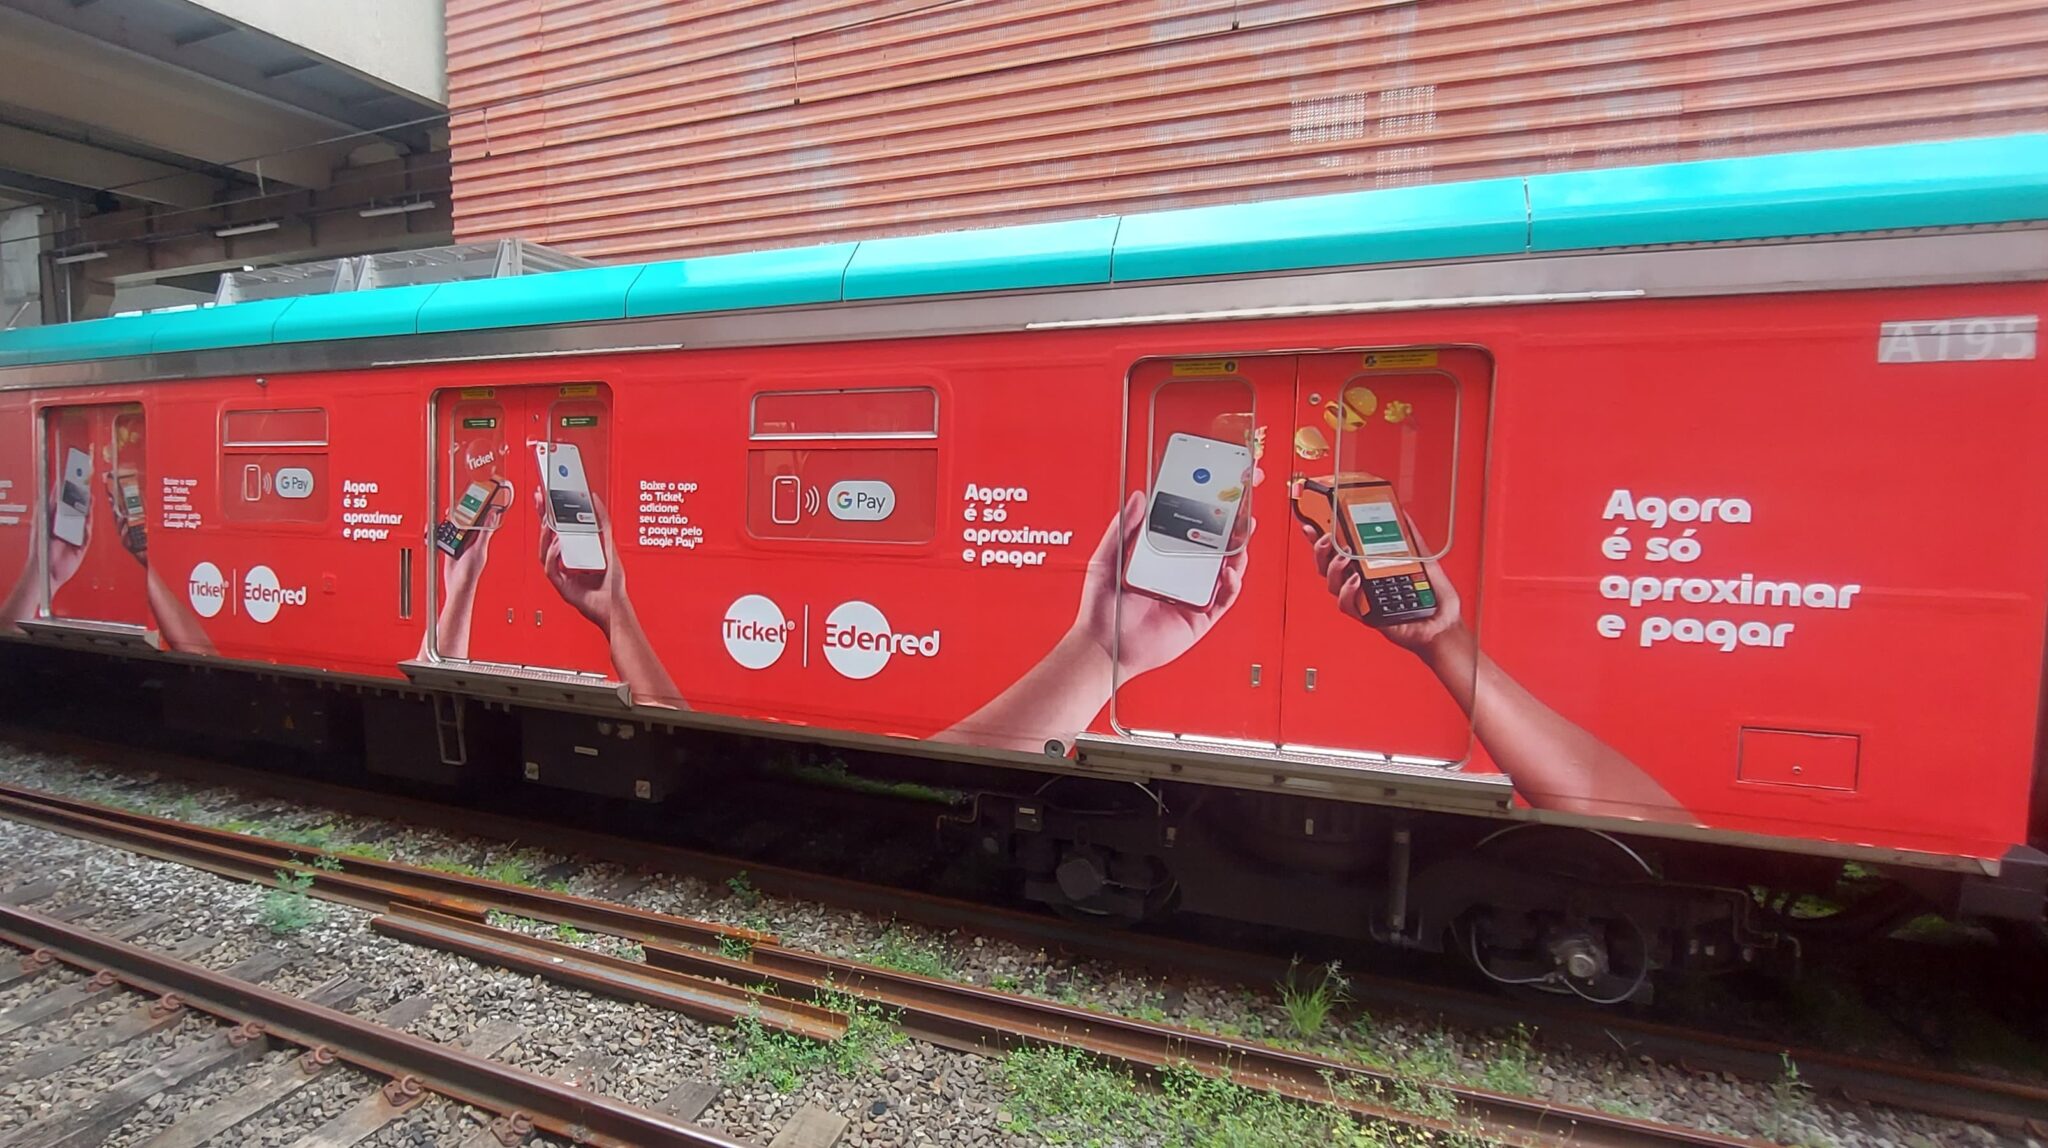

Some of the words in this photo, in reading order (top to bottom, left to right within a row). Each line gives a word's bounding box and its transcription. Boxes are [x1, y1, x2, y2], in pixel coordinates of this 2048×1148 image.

[1880, 317, 2037, 362] A195
[281, 475, 290, 490] G
[292, 476, 309, 492] Pay
[343, 479, 379, 496] Agora
[639, 480, 666, 491] Baixe
[668, 482, 676, 491] o
[677, 482, 698, 493] app
[964, 483, 1028, 503] Agora
[343, 494, 352, 508] é
[353, 494, 368, 509] só
[639, 502, 680, 513] adicione
[836, 491, 853, 509] G
[857, 492, 886, 514] Pay
[1602, 489, 1752, 528] Agora
[343, 511, 403, 526] aproximar
[639, 515, 656, 524] seu
[963, 502, 978, 522] é
[982, 502, 1008, 523] só
[342, 527, 352, 538] e
[353, 528, 390, 542] pagar
[638, 526, 646, 535] e
[647, 526, 679, 538] pague
[680, 525, 703, 538] pelo
[963, 526, 1073, 546] aproximar
[638, 535, 674, 549] Google
[1601, 527, 1632, 560] é
[1644, 528, 1702, 563] só
[962, 548, 977, 563] e
[981, 549, 1047, 568] pagar
[244, 582, 307, 606] Edenred
[1599, 573, 1862, 609] aproximar
[824, 623, 941, 657] Edenred
[1596, 614, 1627, 639] e
[1639, 616, 1796, 652] pagar
